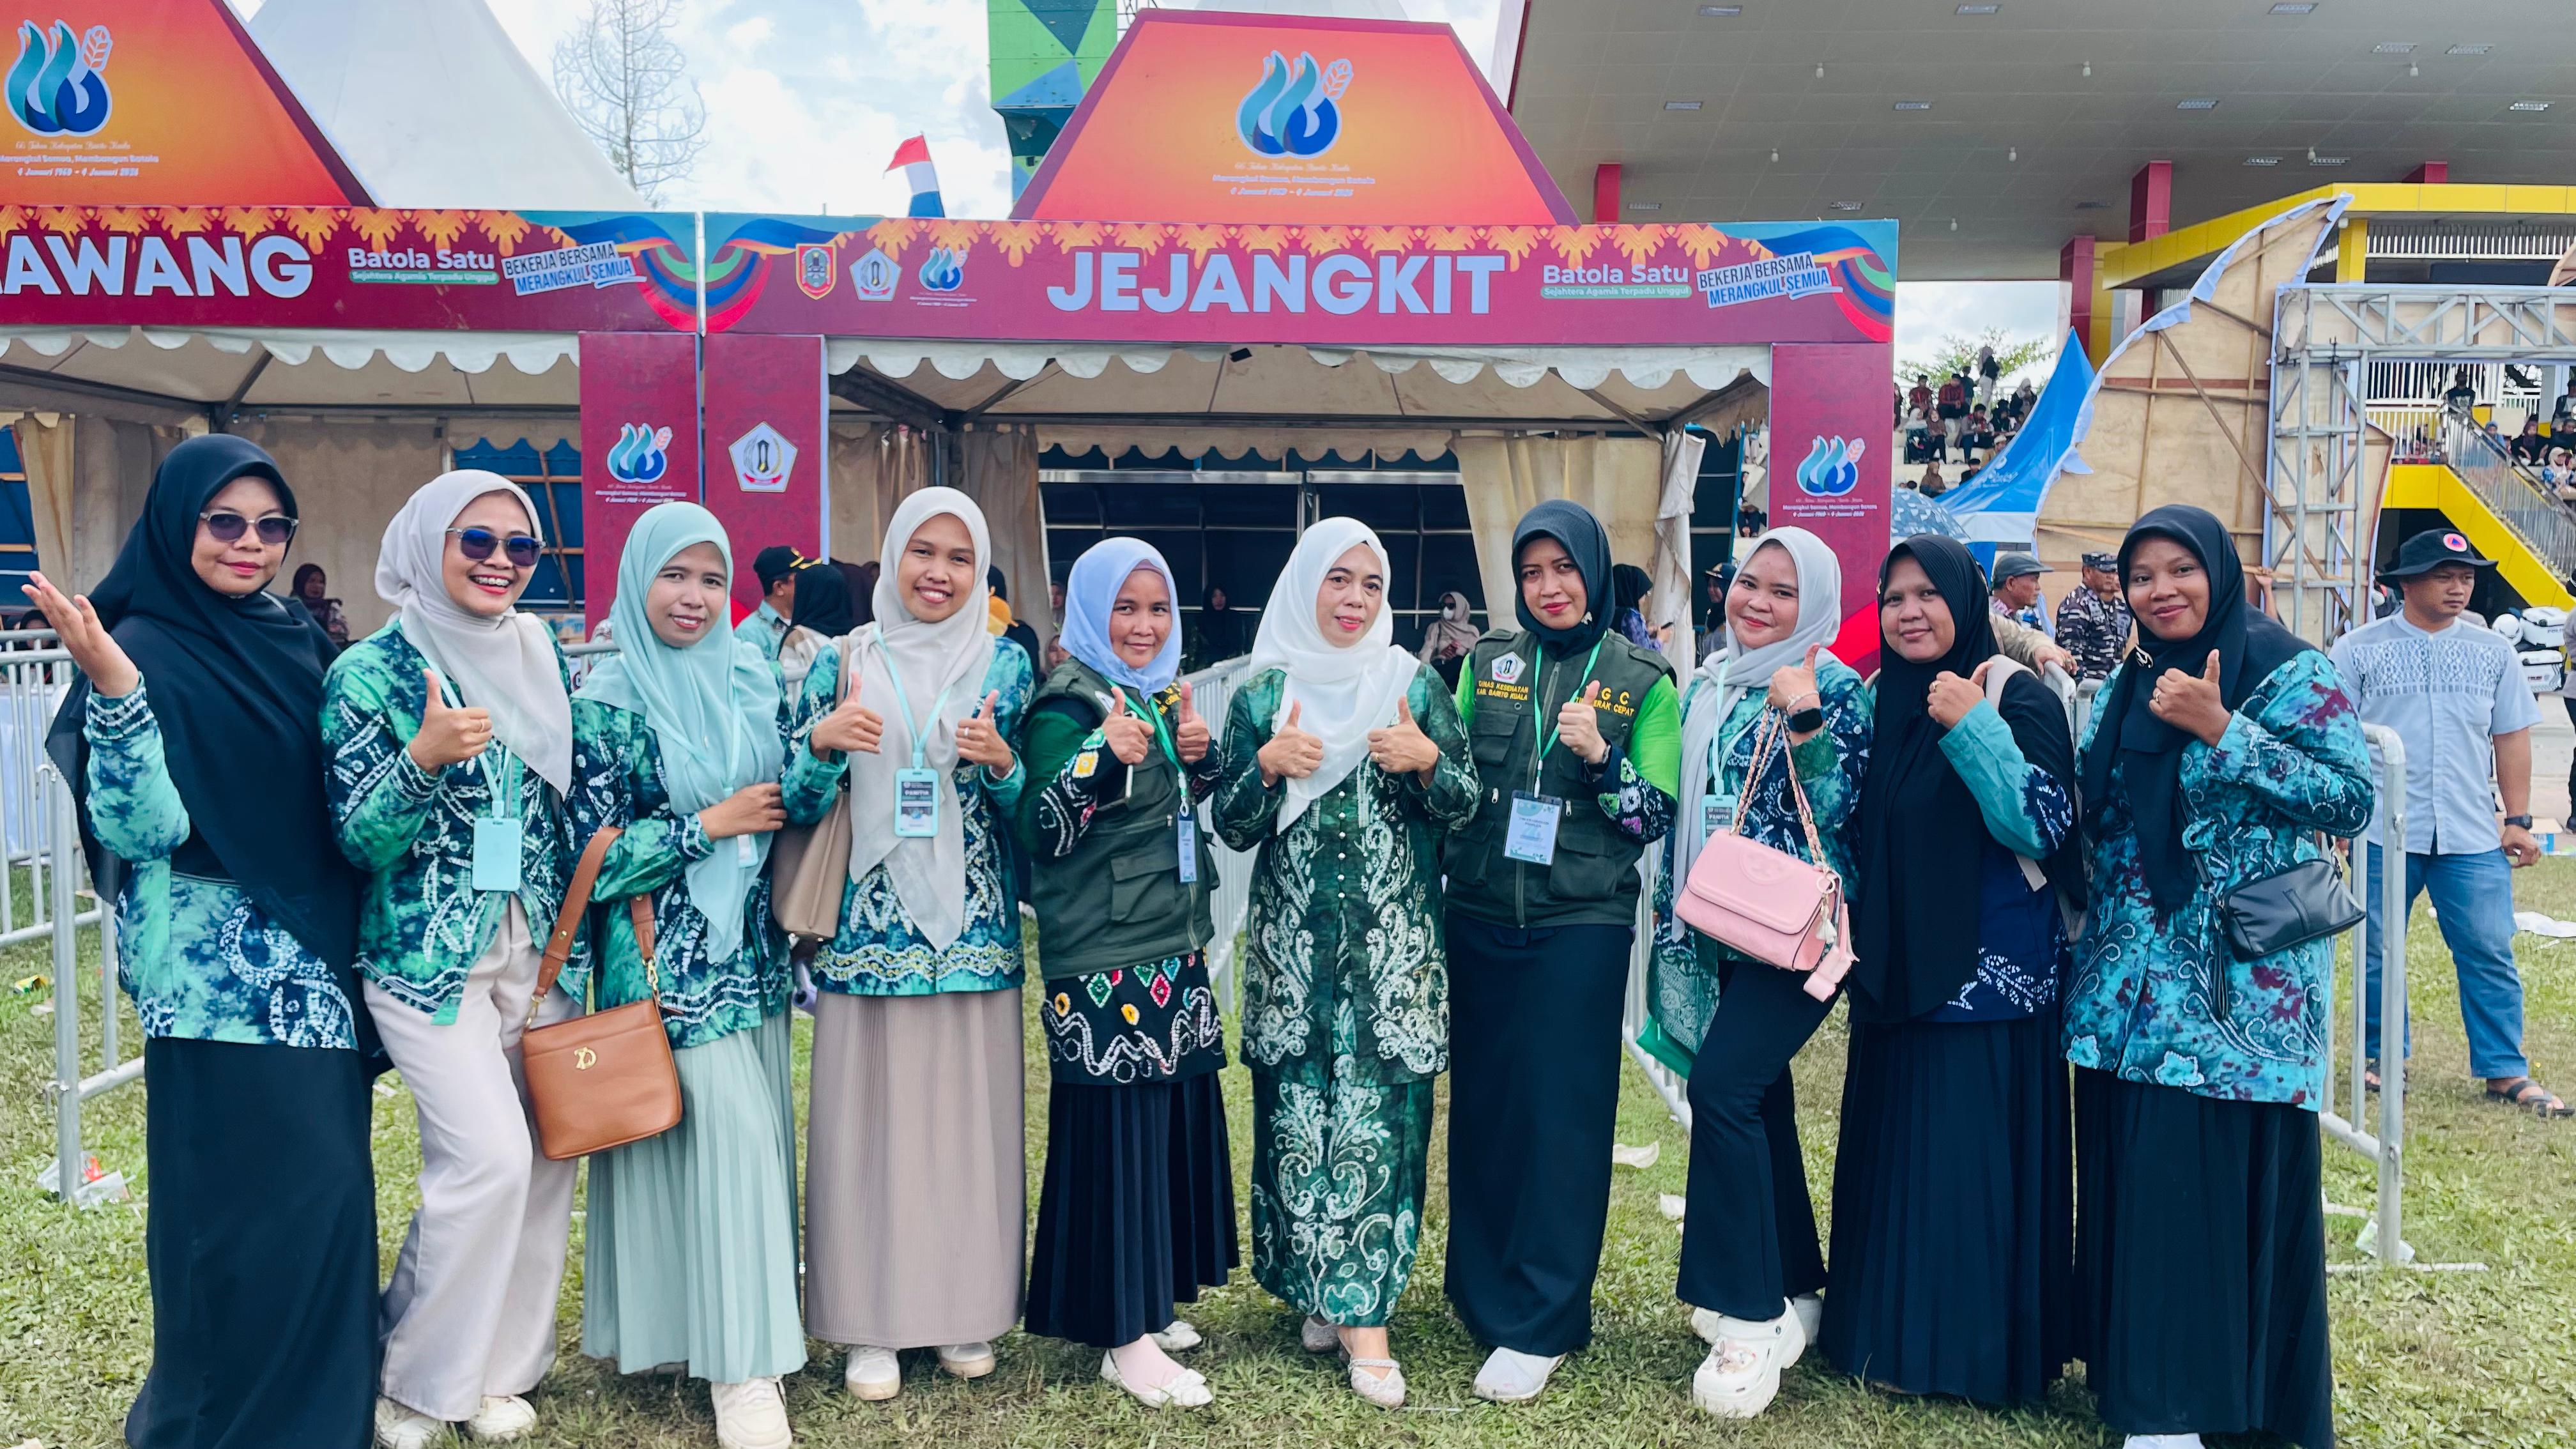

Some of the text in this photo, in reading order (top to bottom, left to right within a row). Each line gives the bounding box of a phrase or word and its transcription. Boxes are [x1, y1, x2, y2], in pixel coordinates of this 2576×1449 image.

[0, 235, 313, 298] AWANG
[348, 247, 494, 269] Batola Satu
[505, 243, 615, 275] BEKERJA BERSAMA
[352, 271, 392, 281] Sejahtera
[516, 259, 632, 292] MERANGKUL SEMUA
[1543, 263, 1689, 284] Batola Satu
[1699, 254, 1813, 288] BEKERJA BERSAMA
[1046, 251, 1505, 315] JEJANGKIT
[1544, 287, 1689, 296] Sejahtera Agamis Terpadu Unggul
[1709, 270, 1829, 305] MERANGKUL SEMUA
[1489, 689, 1508, 698] BARITO
[1496, 683, 1529, 693] KESEHATAN
[1601, 687, 1630, 705] G C
[1593, 700, 1611, 710] ERAK
[1613, 703, 1634, 716] CEPAT
